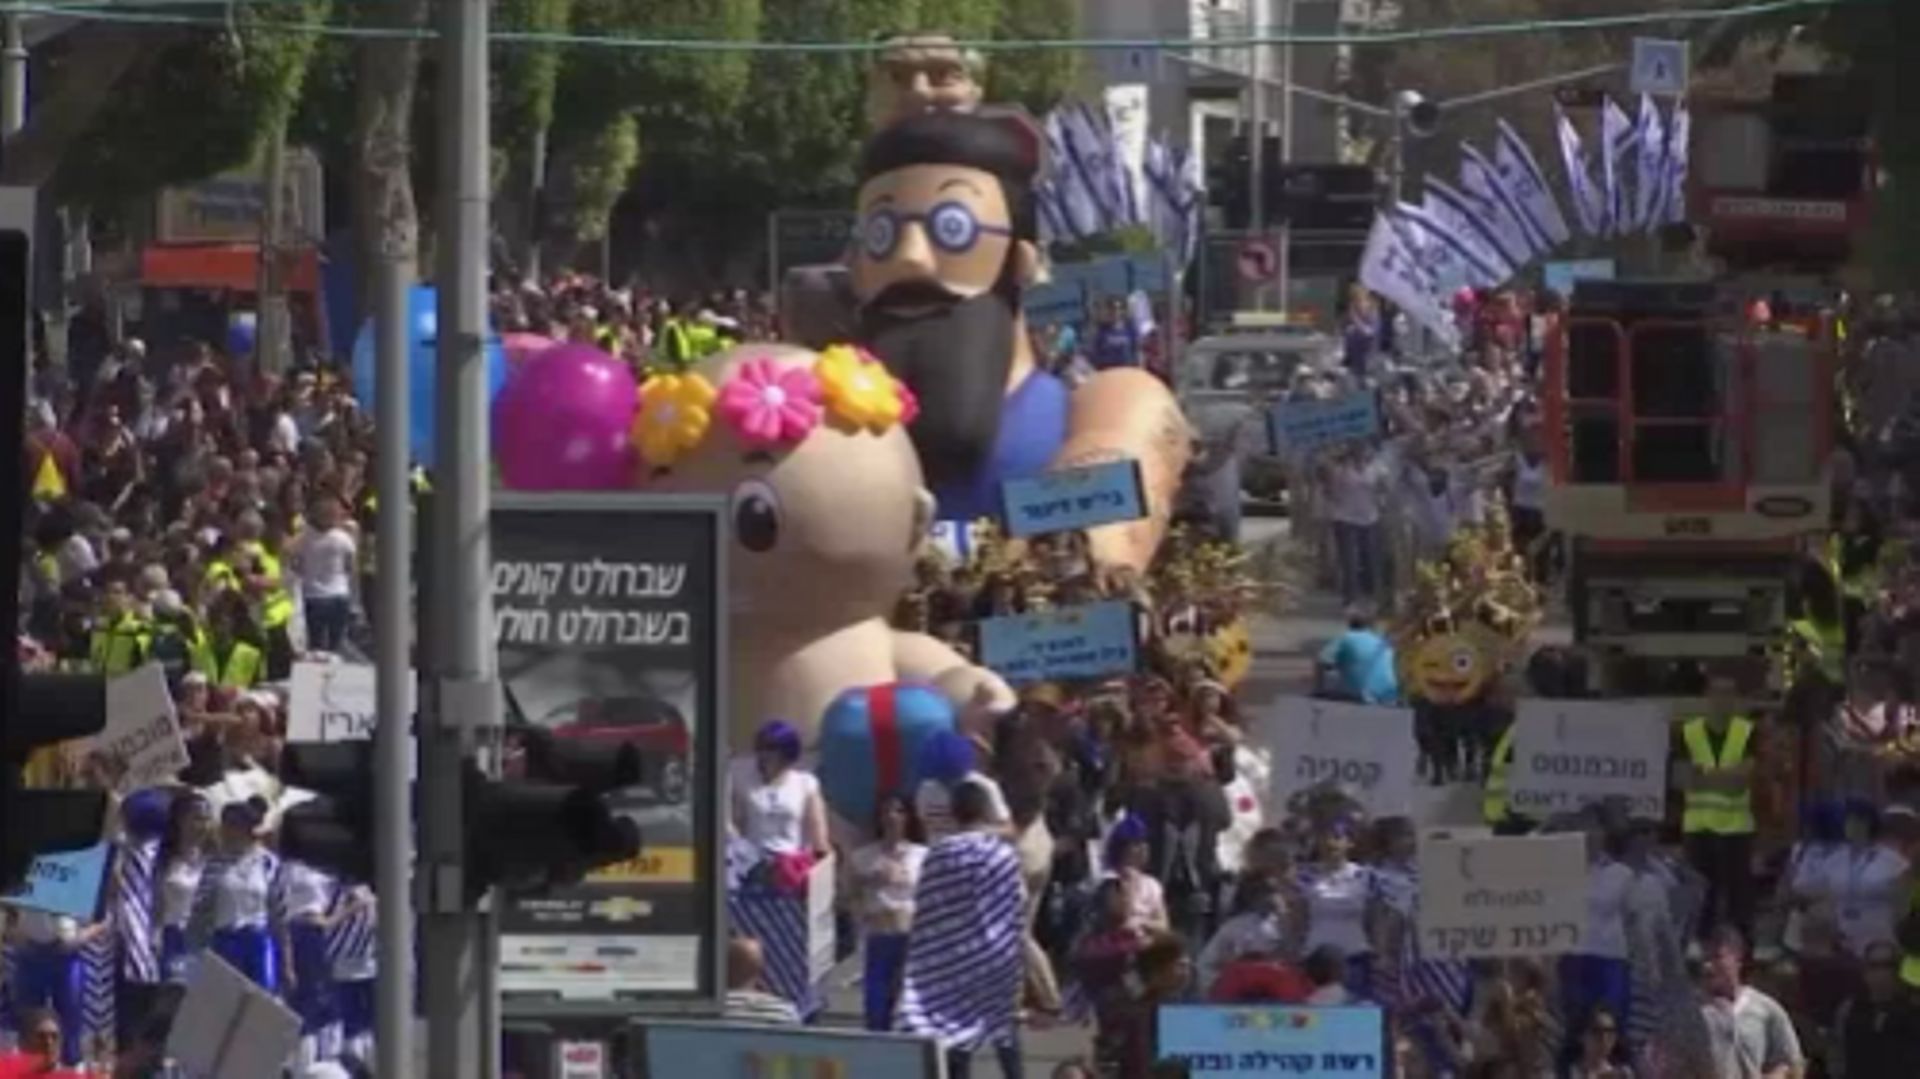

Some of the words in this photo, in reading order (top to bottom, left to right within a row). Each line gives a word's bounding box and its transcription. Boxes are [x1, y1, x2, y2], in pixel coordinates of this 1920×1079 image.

[491, 560, 565, 606] קונים
[570, 557, 688, 598] שברולט
[494, 603, 550, 645] חולו
[558, 604, 692, 645] בשברולט
[1296, 754, 1385, 790] קסניה
[1508, 920, 1580, 949] רינת
